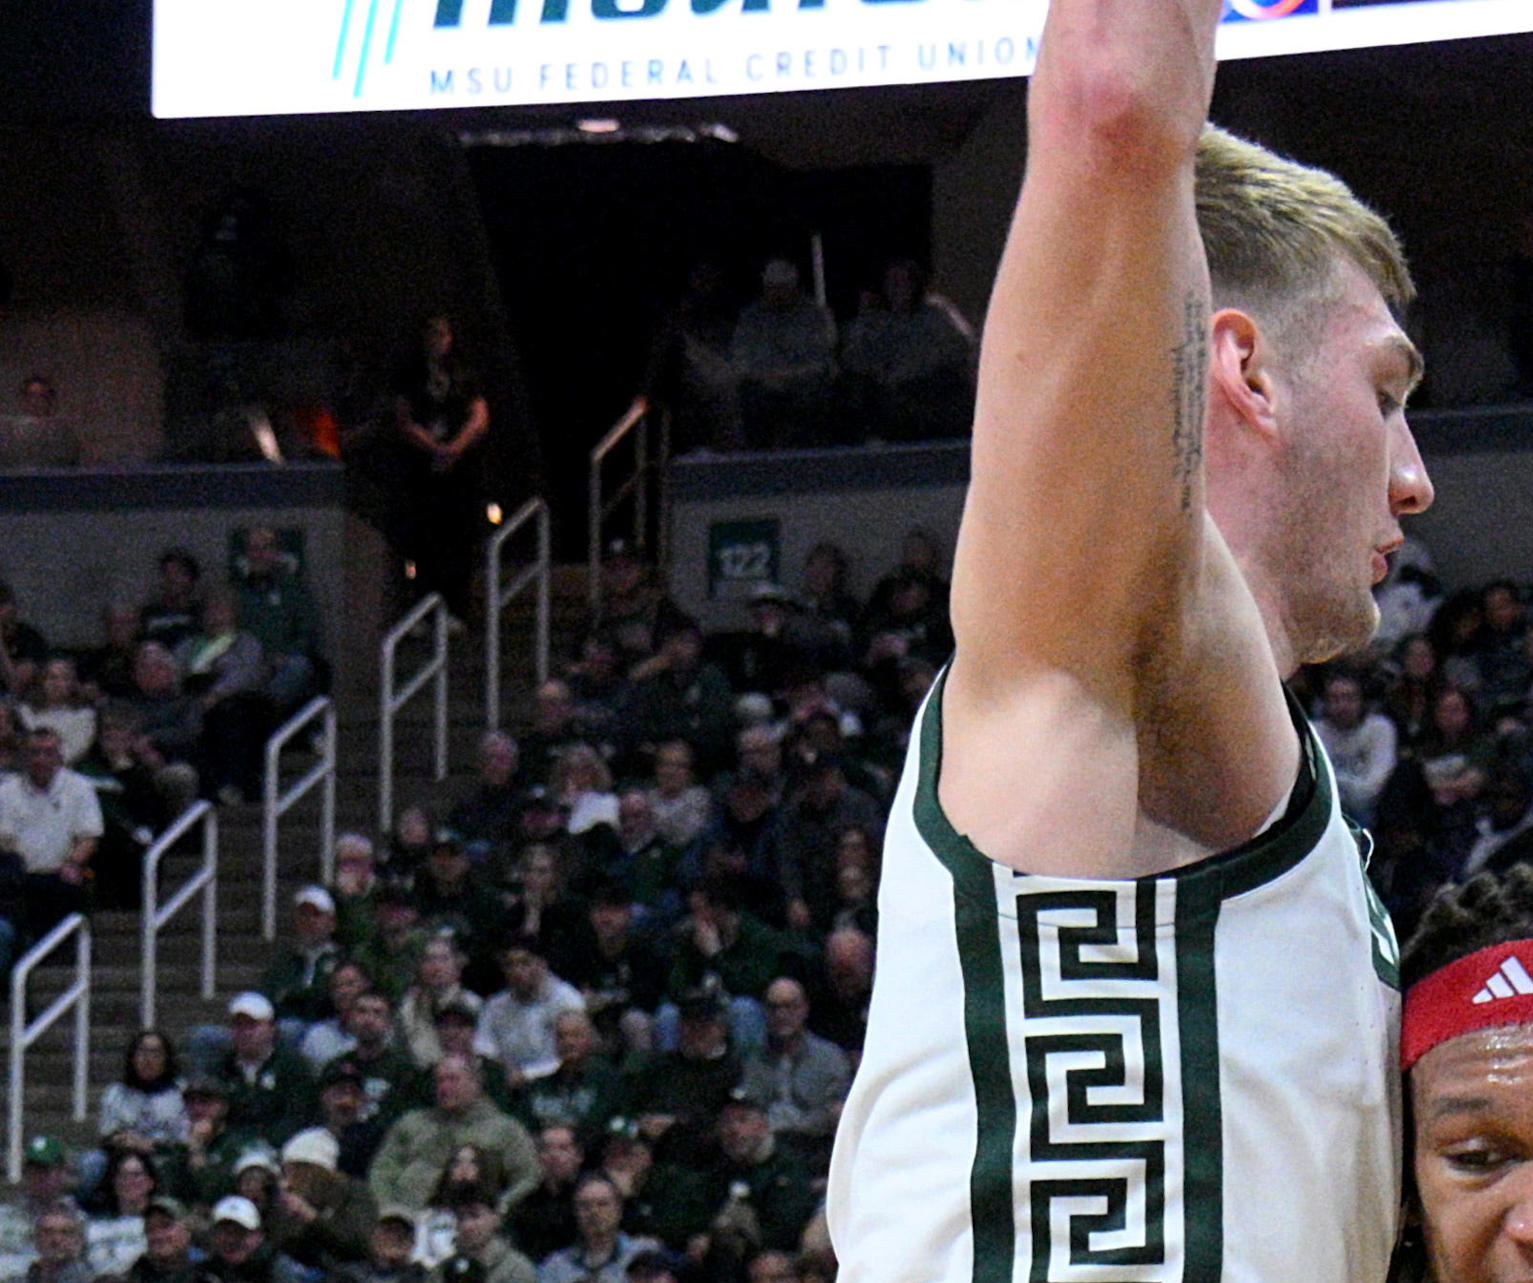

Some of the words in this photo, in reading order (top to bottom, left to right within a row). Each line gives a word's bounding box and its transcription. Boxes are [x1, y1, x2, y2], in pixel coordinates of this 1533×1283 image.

[430, 67, 512, 94] MSU
[540, 58, 717, 91] FEDERAL
[746, 45, 890, 82] CREDIT
